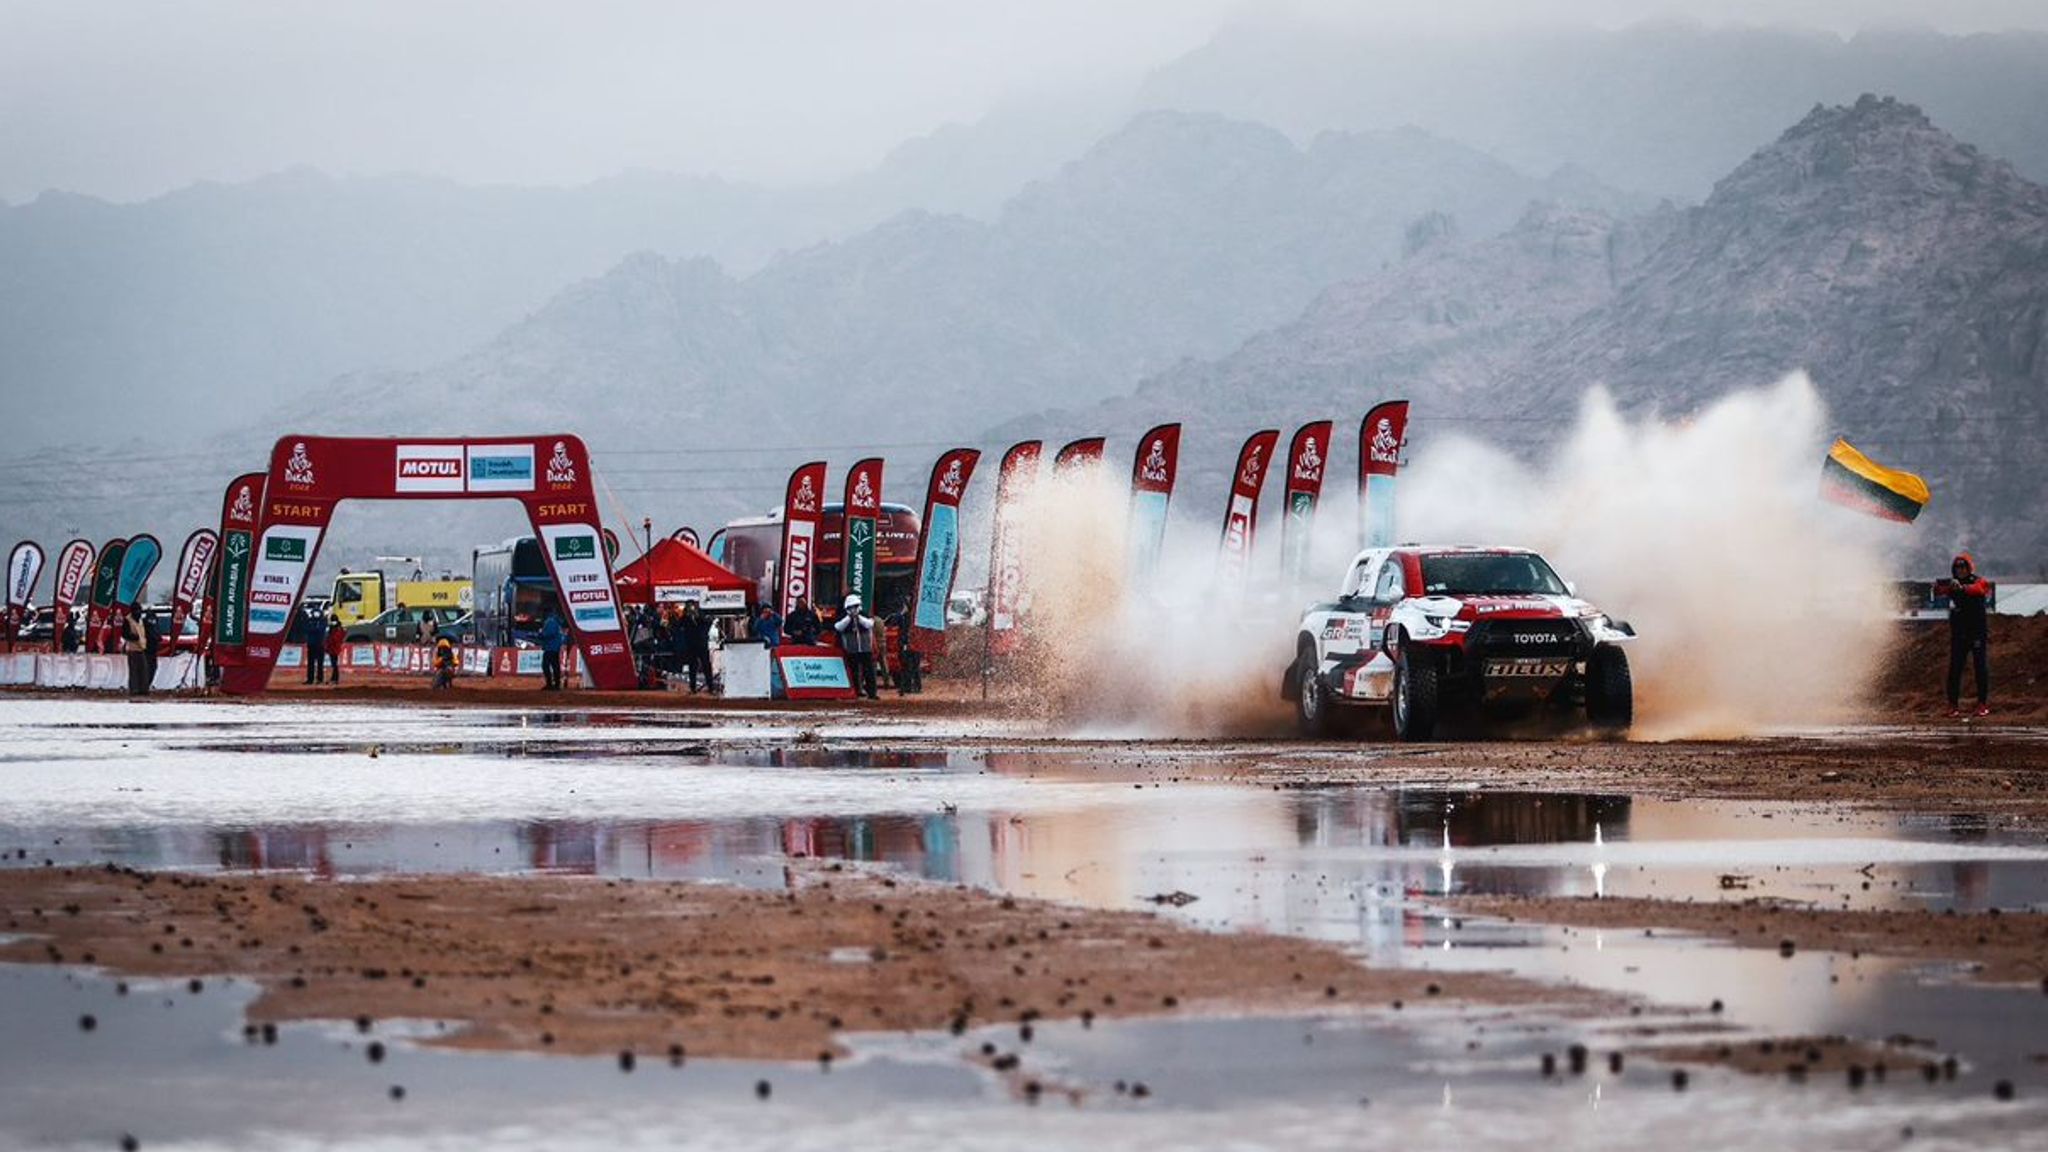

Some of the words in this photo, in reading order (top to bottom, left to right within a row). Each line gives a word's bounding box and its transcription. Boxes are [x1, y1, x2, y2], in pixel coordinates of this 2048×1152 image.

[402, 461, 458, 475] MOTUL
[272, 503, 321, 518] START
[539, 503, 587, 517] START
[184, 537, 214, 594] MOTUL
[853, 551, 863, 591] ARABIA
[62, 549, 87, 597] MOTUL
[228, 563, 239, 602] ARABIA
[253, 592, 289, 604] MOTUL
[571, 591, 607, 602] MOTUL
[226, 604, 236, 636] SAUDI
[1513, 633, 1558, 644] TOYOTA
[1484, 663, 1569, 677] HILUX
